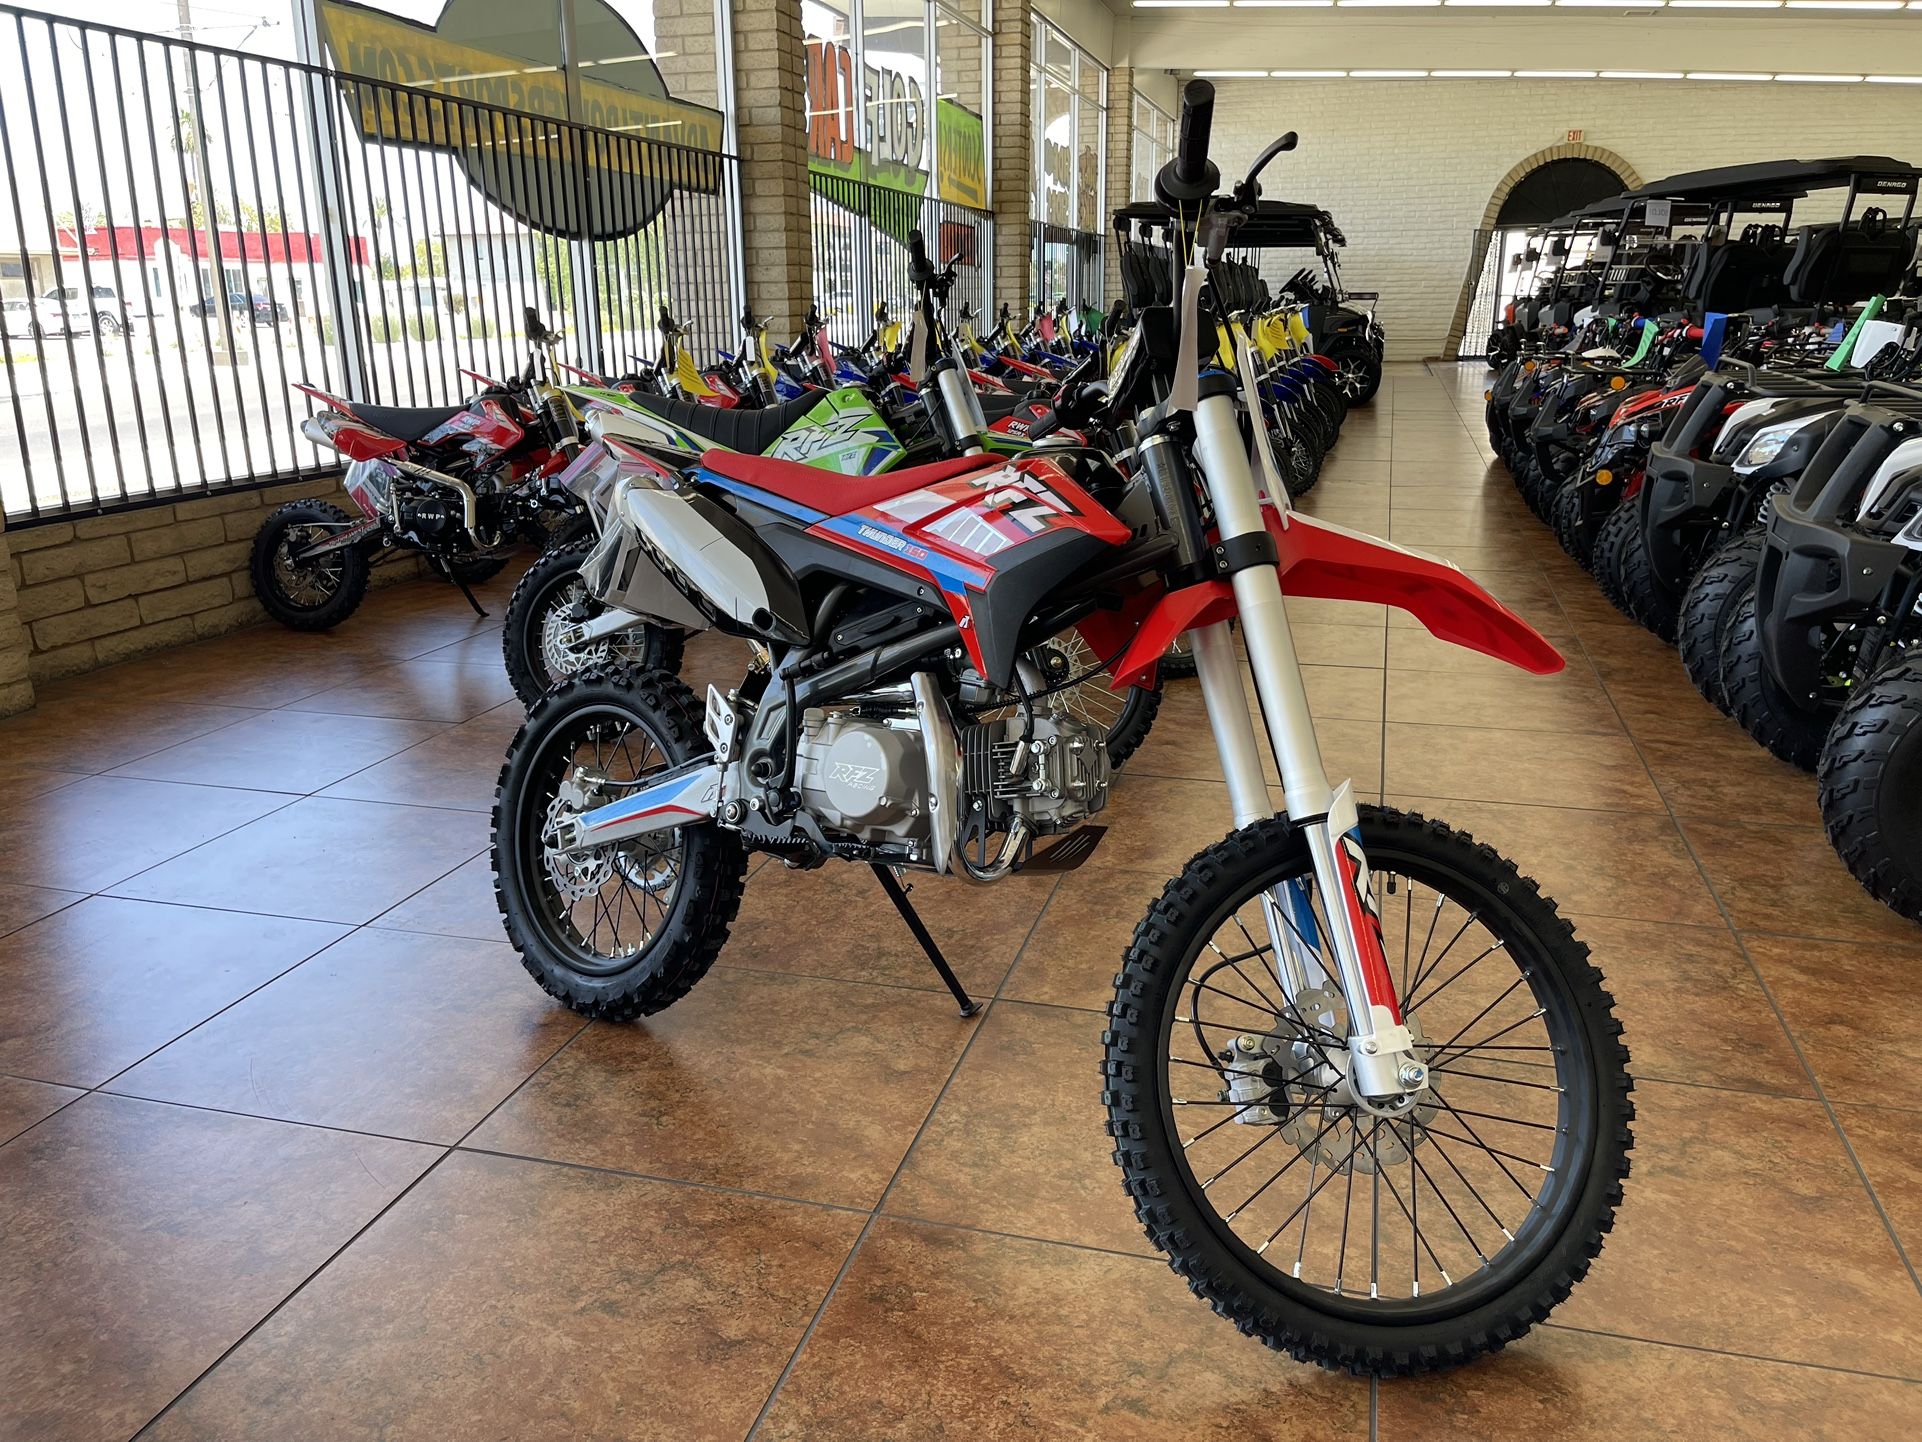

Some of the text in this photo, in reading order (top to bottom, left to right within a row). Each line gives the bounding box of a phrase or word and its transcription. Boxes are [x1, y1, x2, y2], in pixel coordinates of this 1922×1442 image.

[1568, 130, 1582, 141] EXIT
[1877, 180, 1907, 188] DENAGO
[422, 512, 440, 520] RWP
[858, 524, 907, 551] THUNDER
[829, 762, 880, 783] RFZ
